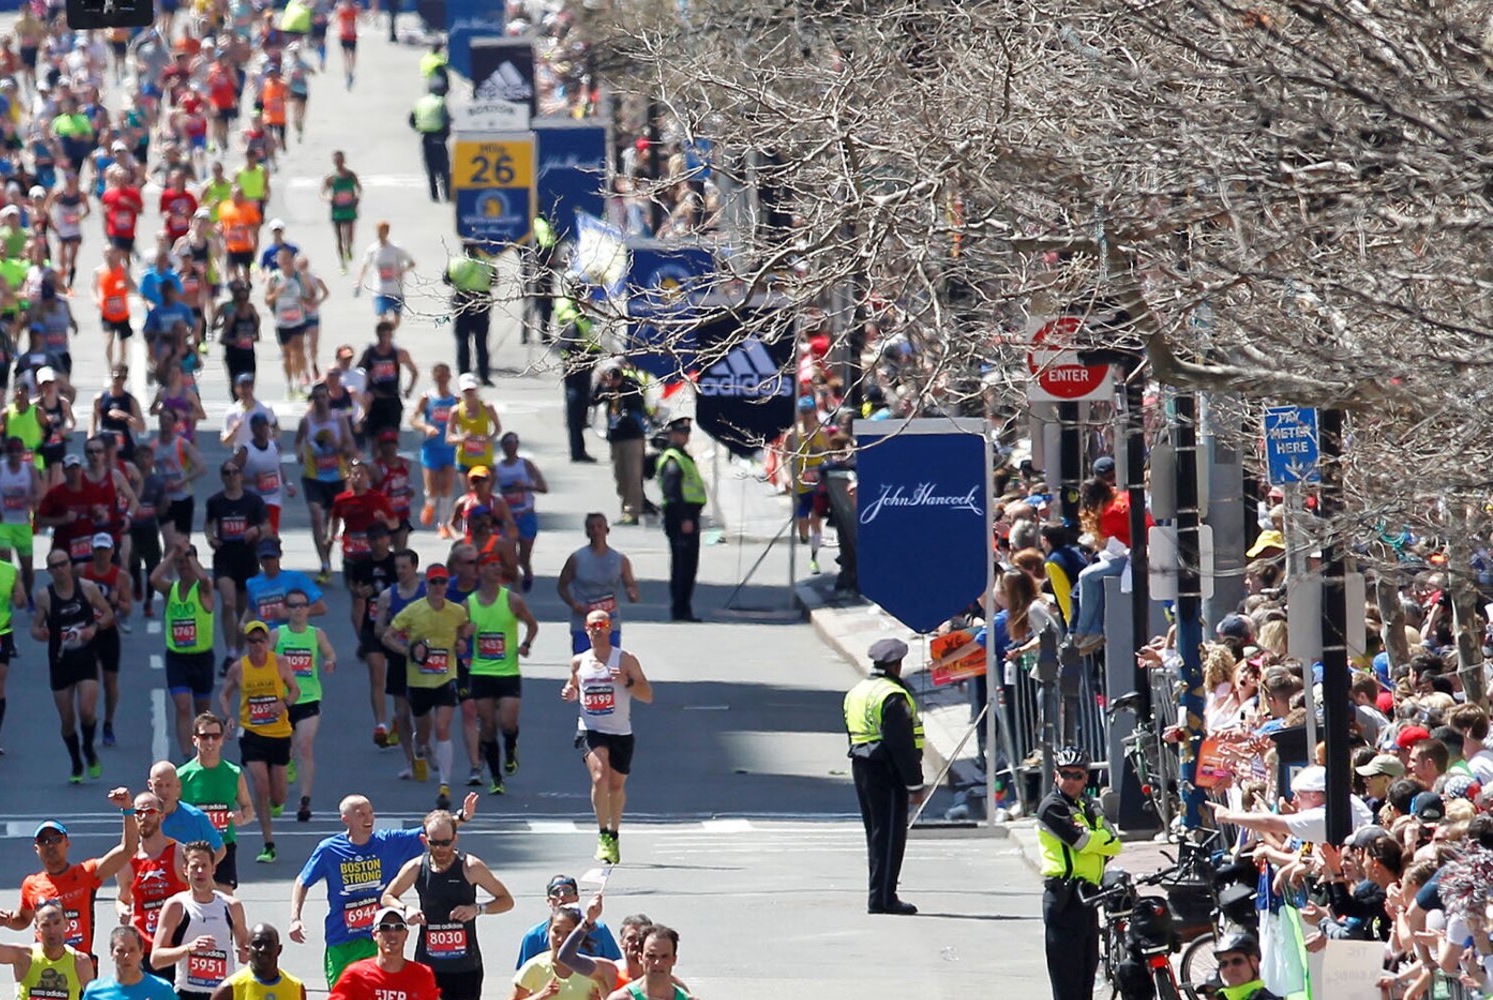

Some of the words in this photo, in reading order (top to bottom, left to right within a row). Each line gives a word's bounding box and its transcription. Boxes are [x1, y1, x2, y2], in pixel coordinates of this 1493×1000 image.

[469, 155, 516, 184] 26
[1048, 368, 1090, 384] ENTER
[1276, 440, 1309, 455] HERE
[584, 695, 612, 705] 5199
[340, 859, 381, 875] BOSTON
[342, 871, 382, 885] STRONG
[348, 905, 377, 922] 6944
[429, 931, 463, 944] 8030
[191, 959, 224, 973] 5951
